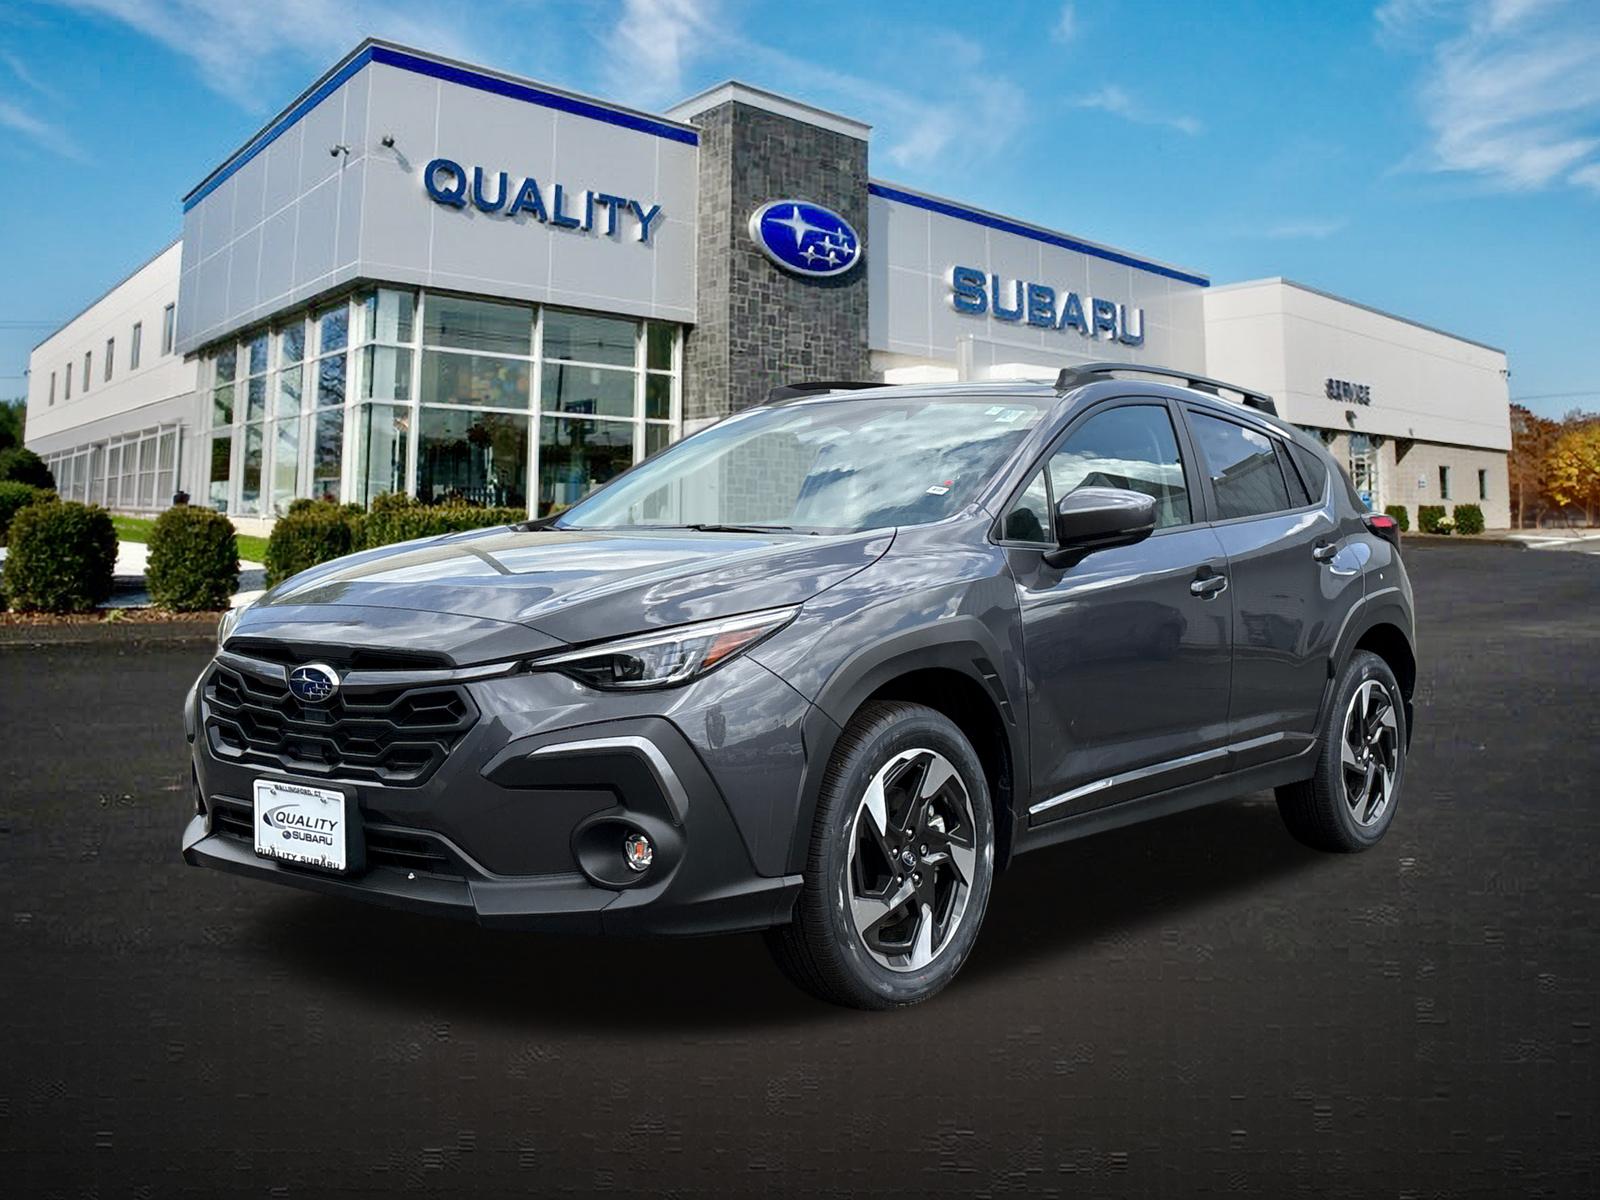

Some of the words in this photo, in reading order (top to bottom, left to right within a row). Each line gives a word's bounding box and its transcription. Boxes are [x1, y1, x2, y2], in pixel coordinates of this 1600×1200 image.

[423, 158, 662, 243] QUALITY
[949, 265, 1145, 346] SUBARU
[1325, 378, 1371, 406] SERVICE
[275, 811, 338, 831] QUALITY
[292, 831, 333, 846] SUBARU
[257, 847, 297, 861] QUALITY
[301, 855, 341, 869] SUBARU
